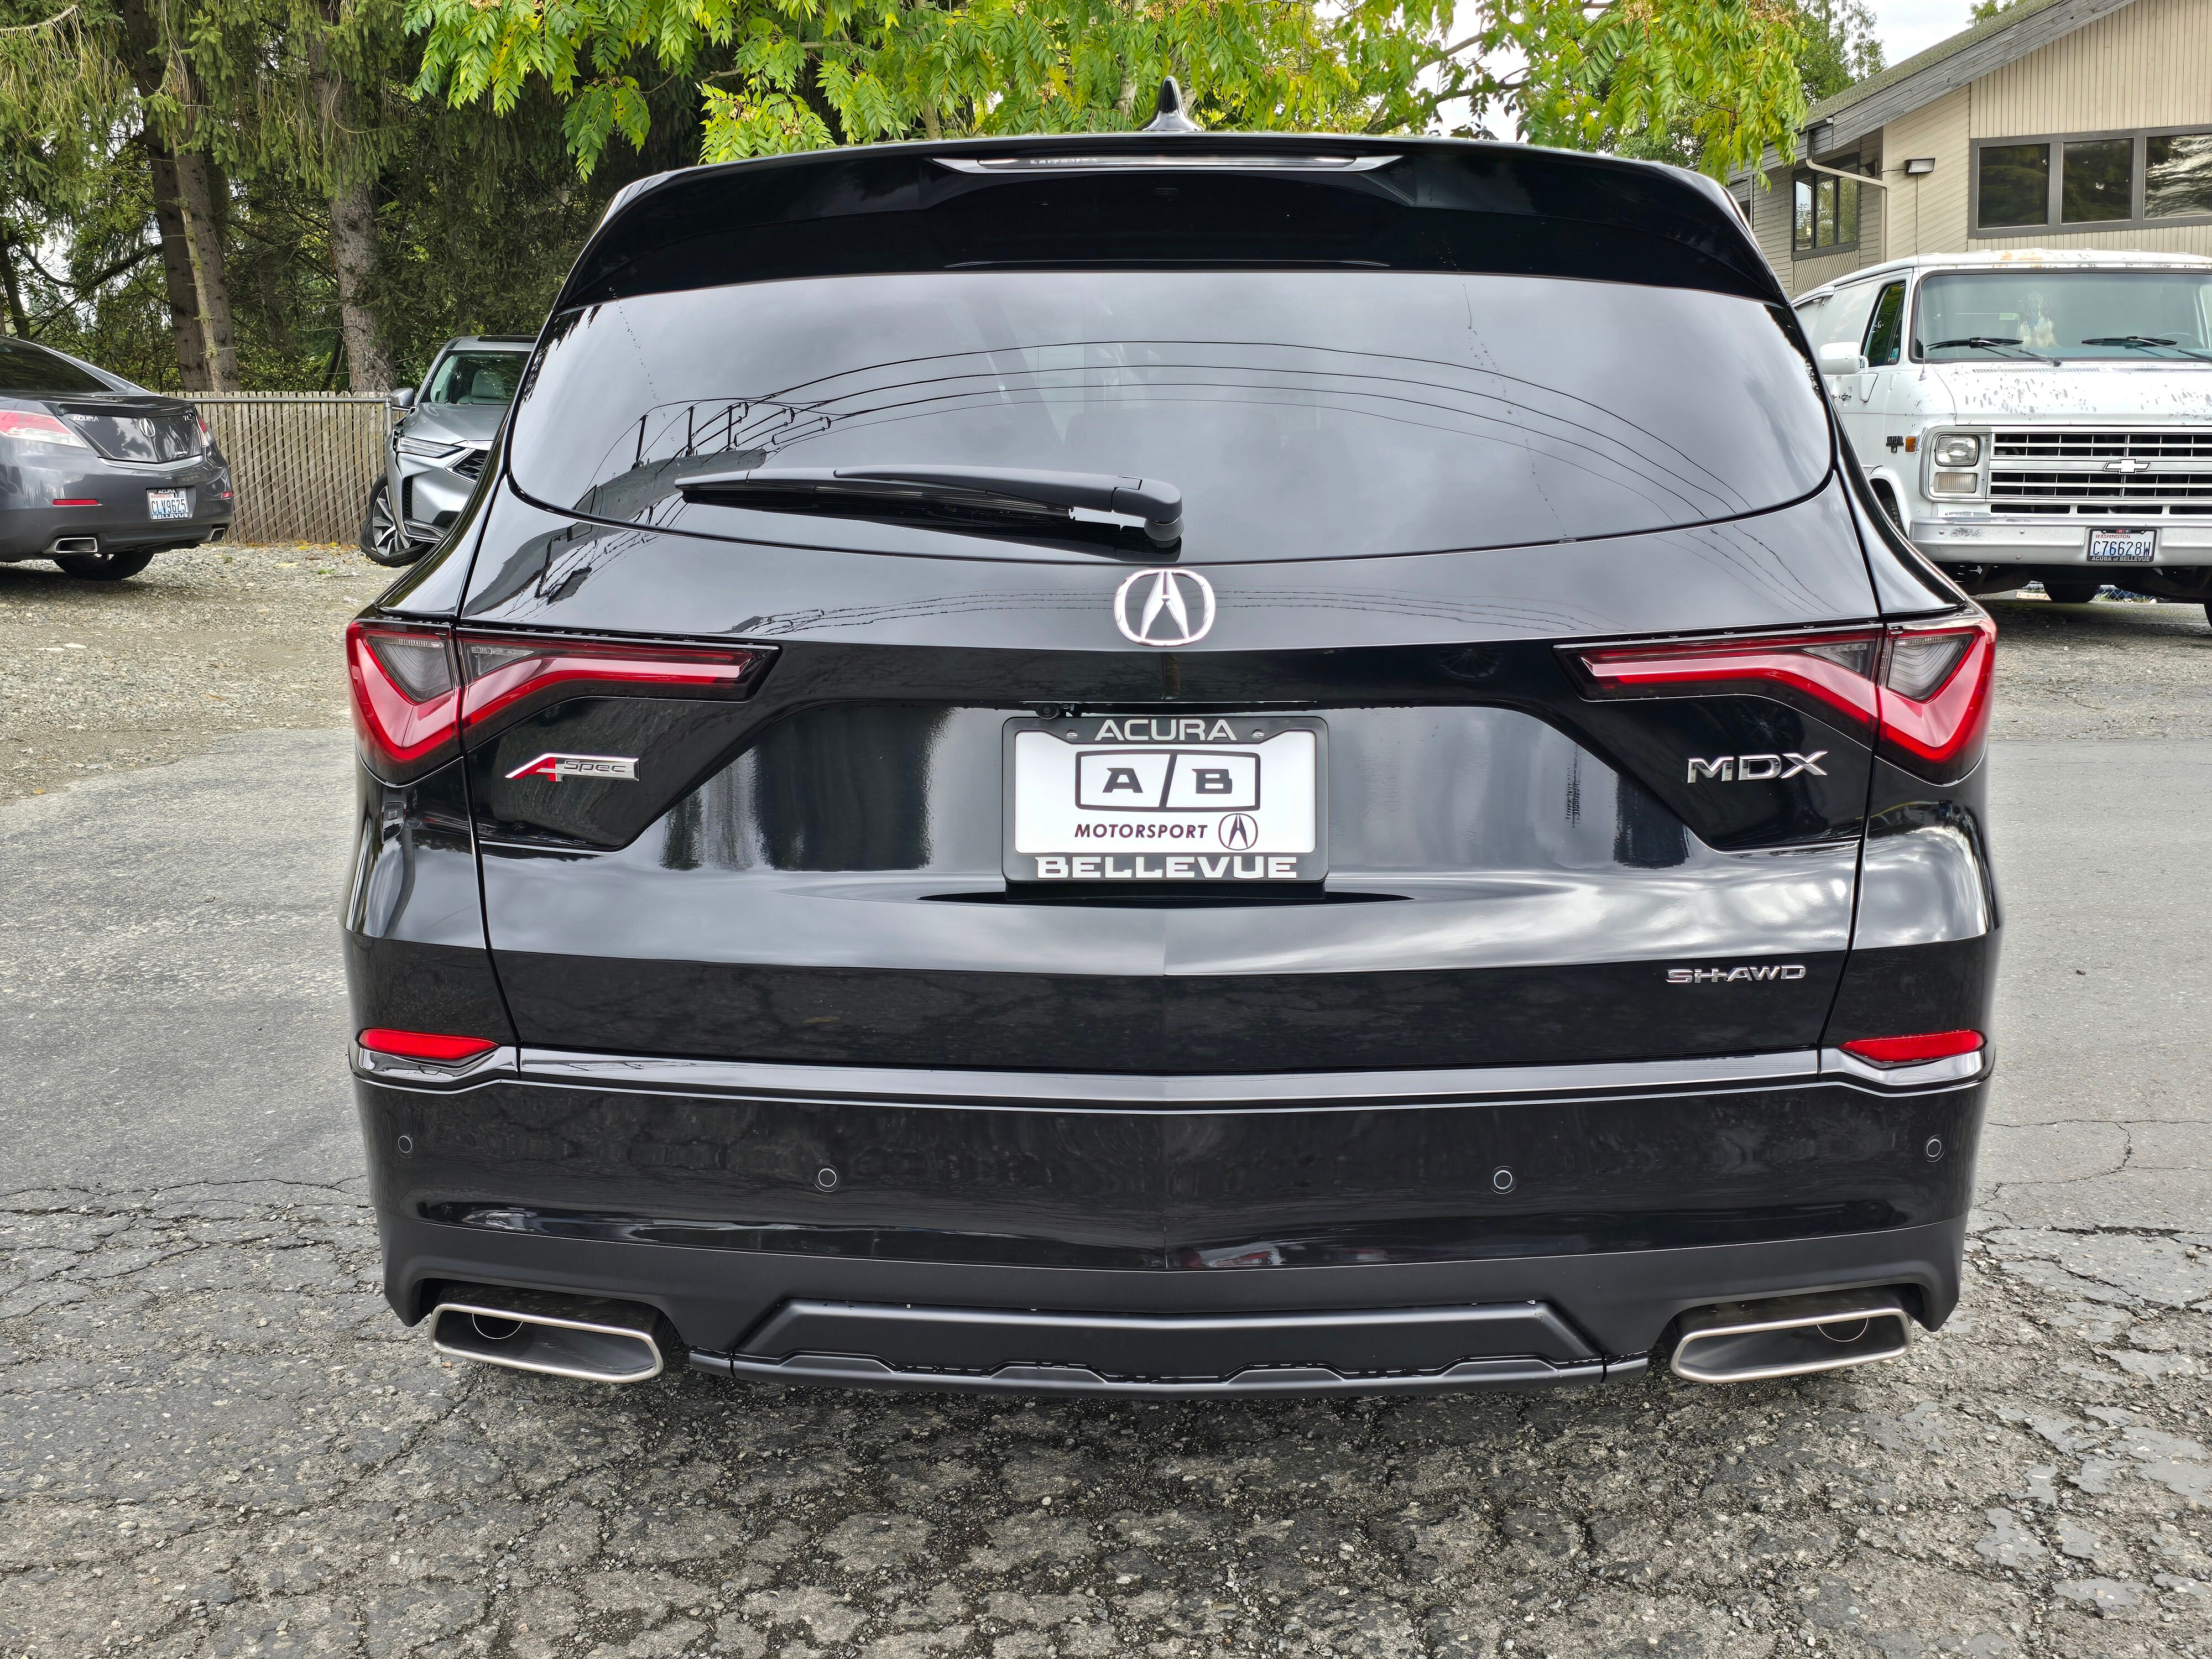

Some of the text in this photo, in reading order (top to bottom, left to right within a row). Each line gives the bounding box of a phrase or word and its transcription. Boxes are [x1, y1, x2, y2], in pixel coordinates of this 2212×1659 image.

[152, 499, 186, 514] CLV9625
[2093, 541, 2151, 556] C76628W
[1094, 719, 1238, 742] ACURA
[1687, 750, 1828, 783] MDX
[1074, 823, 1208, 839] MOTORSPORT
[1034, 857, 1297, 879] BELLEVUE
[1665, 965, 1806, 983] SH-AWD
